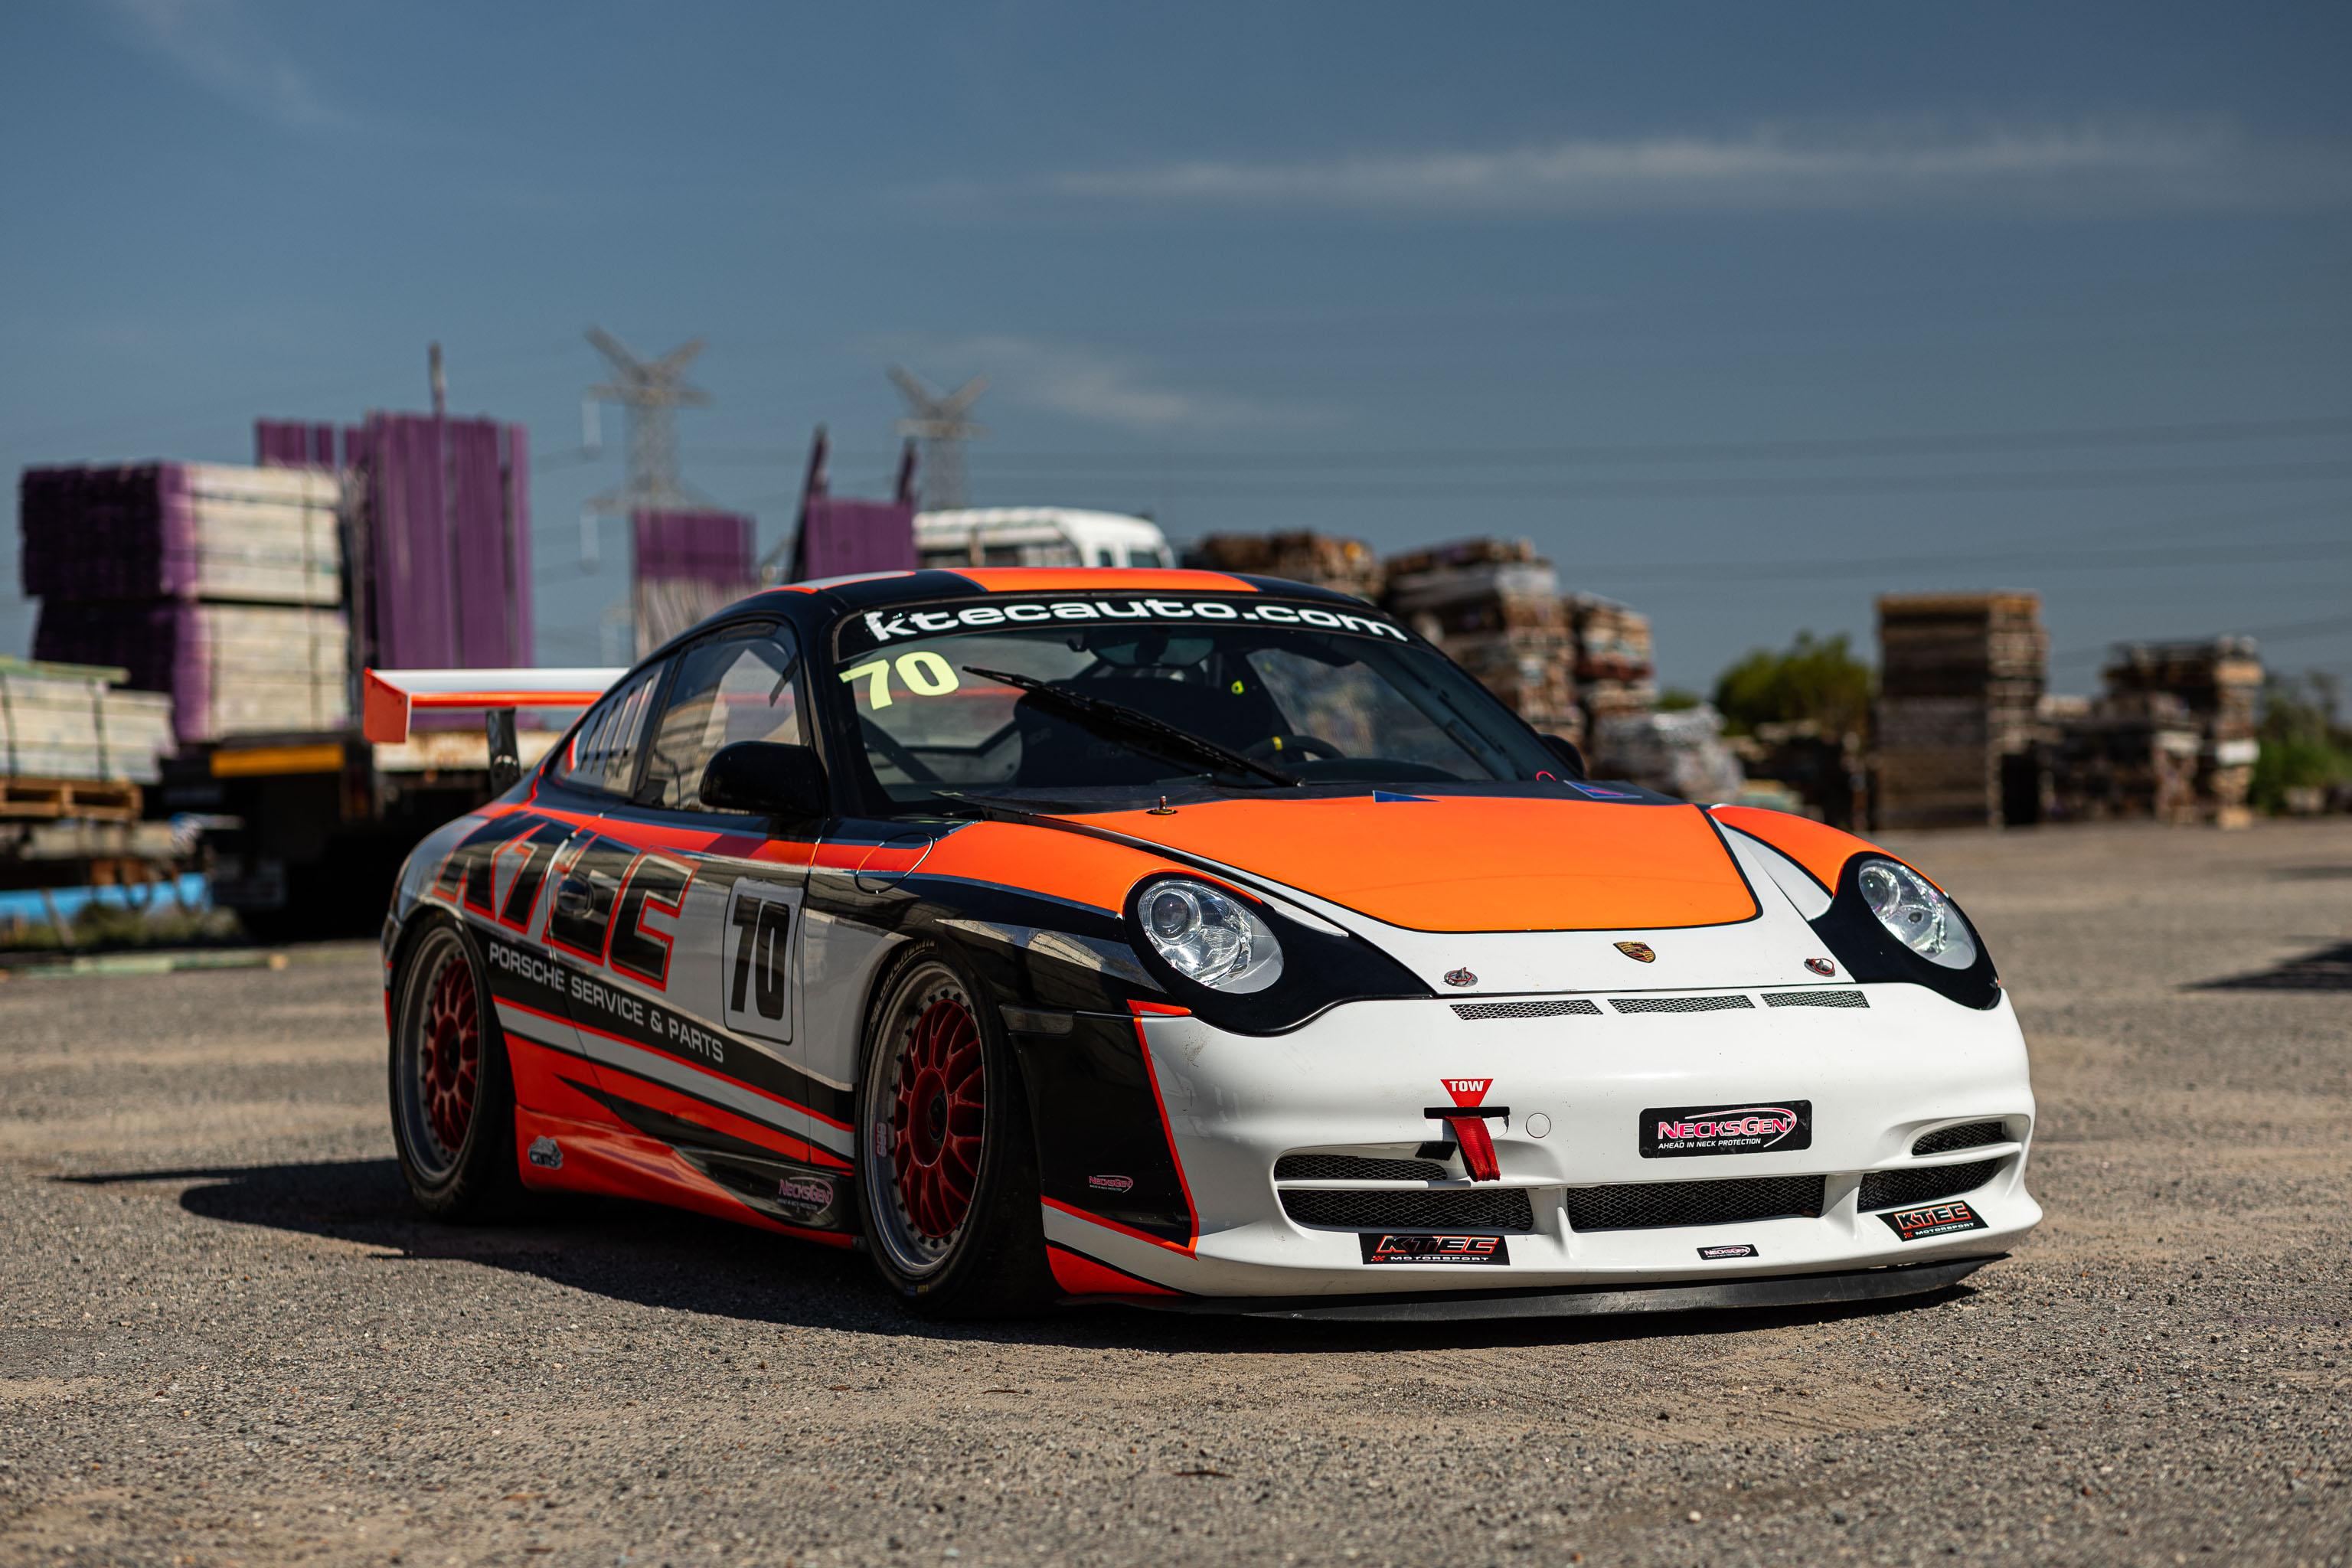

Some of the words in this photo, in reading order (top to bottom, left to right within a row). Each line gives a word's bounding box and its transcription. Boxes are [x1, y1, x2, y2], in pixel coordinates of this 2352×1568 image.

[864, 599, 1408, 642] ktecauto.com
[838, 652, 959, 710] 70
[730, 894, 789, 1021] 70
[490, 942, 564, 991] PORSCHE
[571, 975, 644, 1026] SERVICE
[651, 1010, 663, 1034] &
[668, 1018, 724, 1063] PARTS
[1449, 1080, 1484, 1092] TOW
[1718, 1138, 1761, 1147] PROTECTION
[1894, 1202, 1971, 1230] KTEC
[1915, 1222, 1975, 1235] MOTORSPORT
[1376, 1235, 1499, 1254] KTEC
